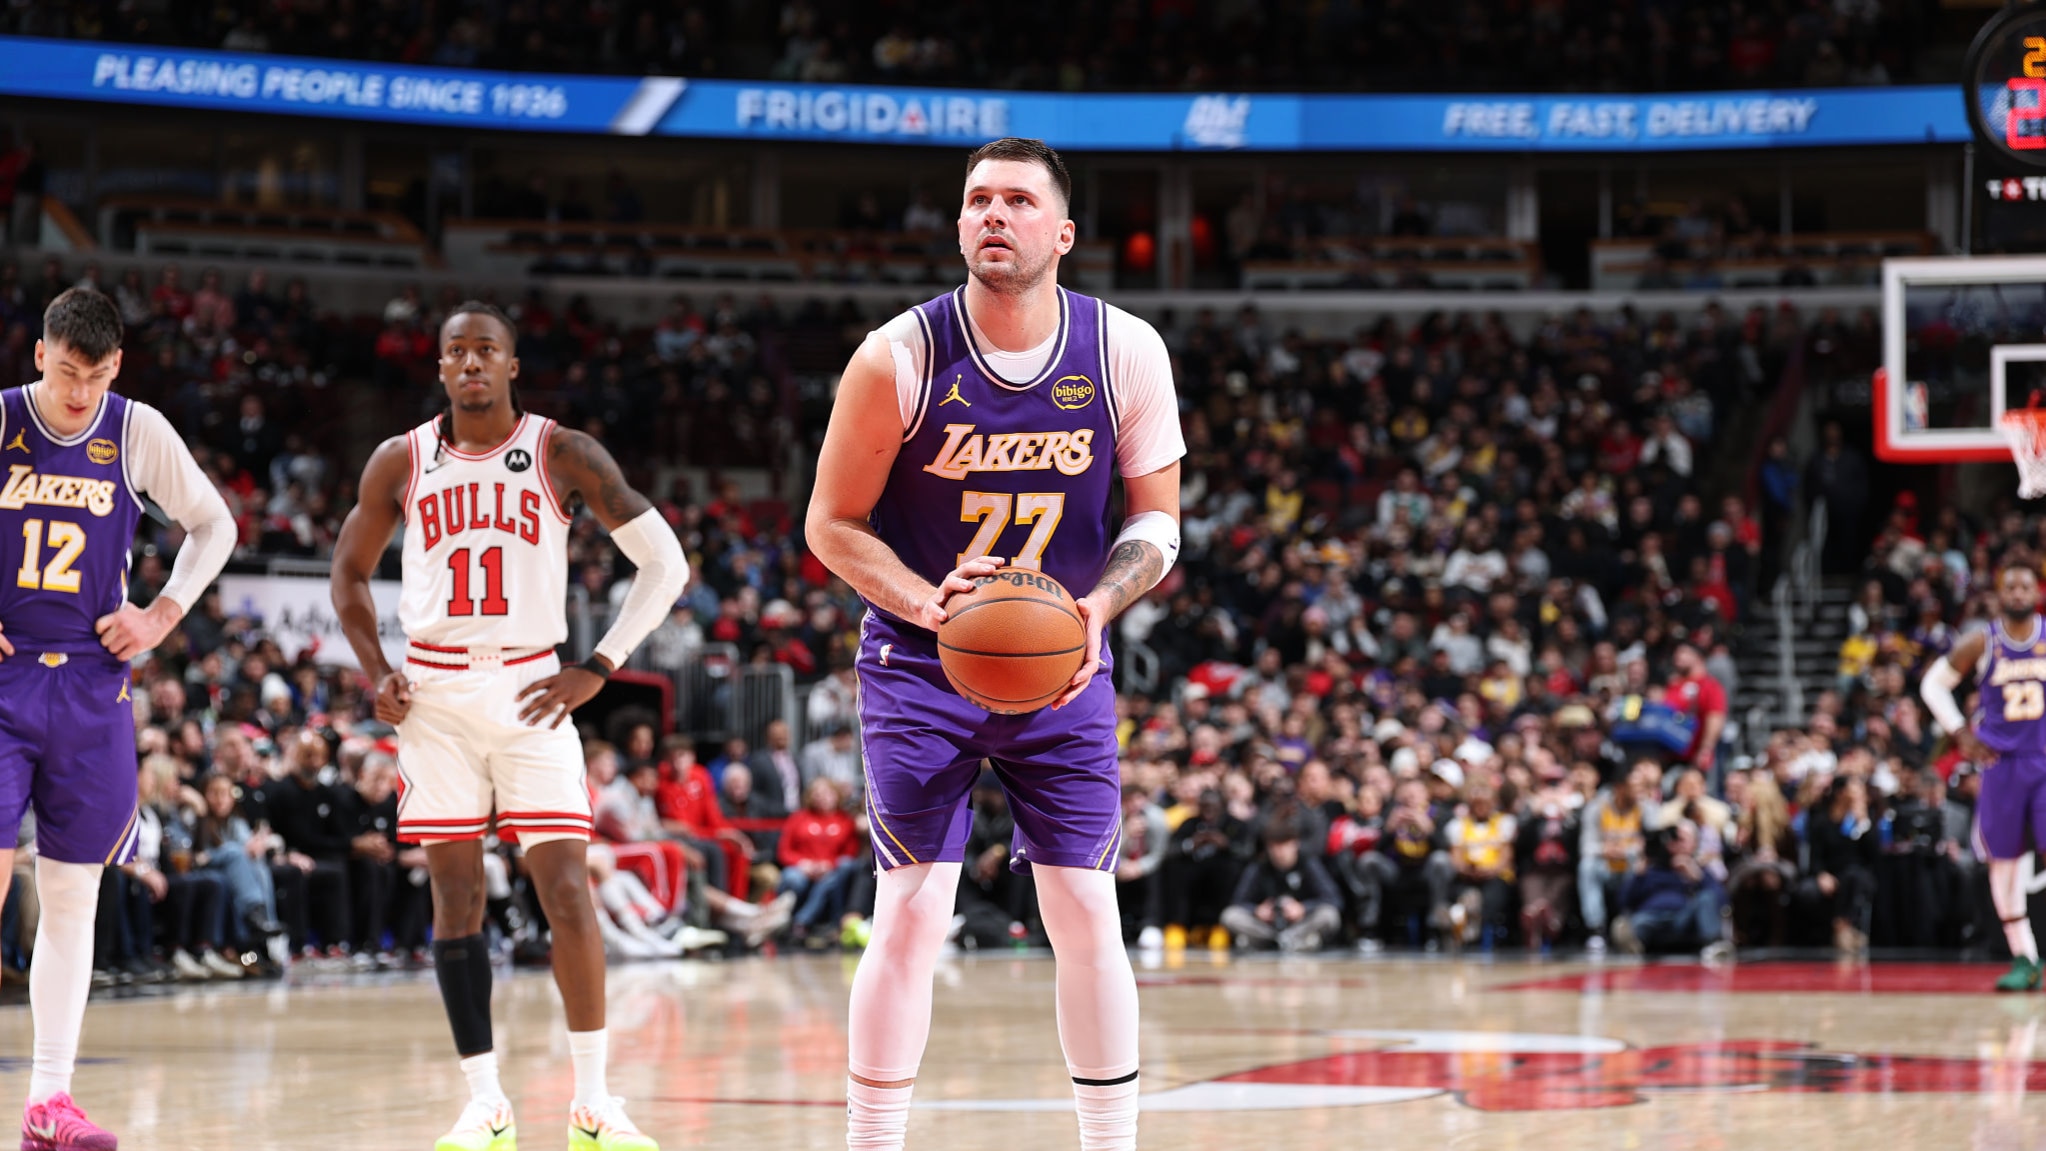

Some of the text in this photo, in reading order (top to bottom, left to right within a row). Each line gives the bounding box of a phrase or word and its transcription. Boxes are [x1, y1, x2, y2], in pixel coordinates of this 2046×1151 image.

[93, 54, 567, 118] PLEASING PEOPLE SINCE 1936
[736, 88, 1008, 137] FRIGIDAIRE
[1443, 98, 1818, 142] FREE, FAST, DELIVERY
[1055, 384, 1092, 399] bibigo
[923, 423, 1095, 480] LAKERS
[0, 464, 116, 517] LAKERS
[418, 483, 540, 552] BULLS
[17, 518, 87, 594] 12
[956, 490, 1066, 572] 77
[447, 547, 509, 616] 11
[2002, 680, 2045, 722] 23
